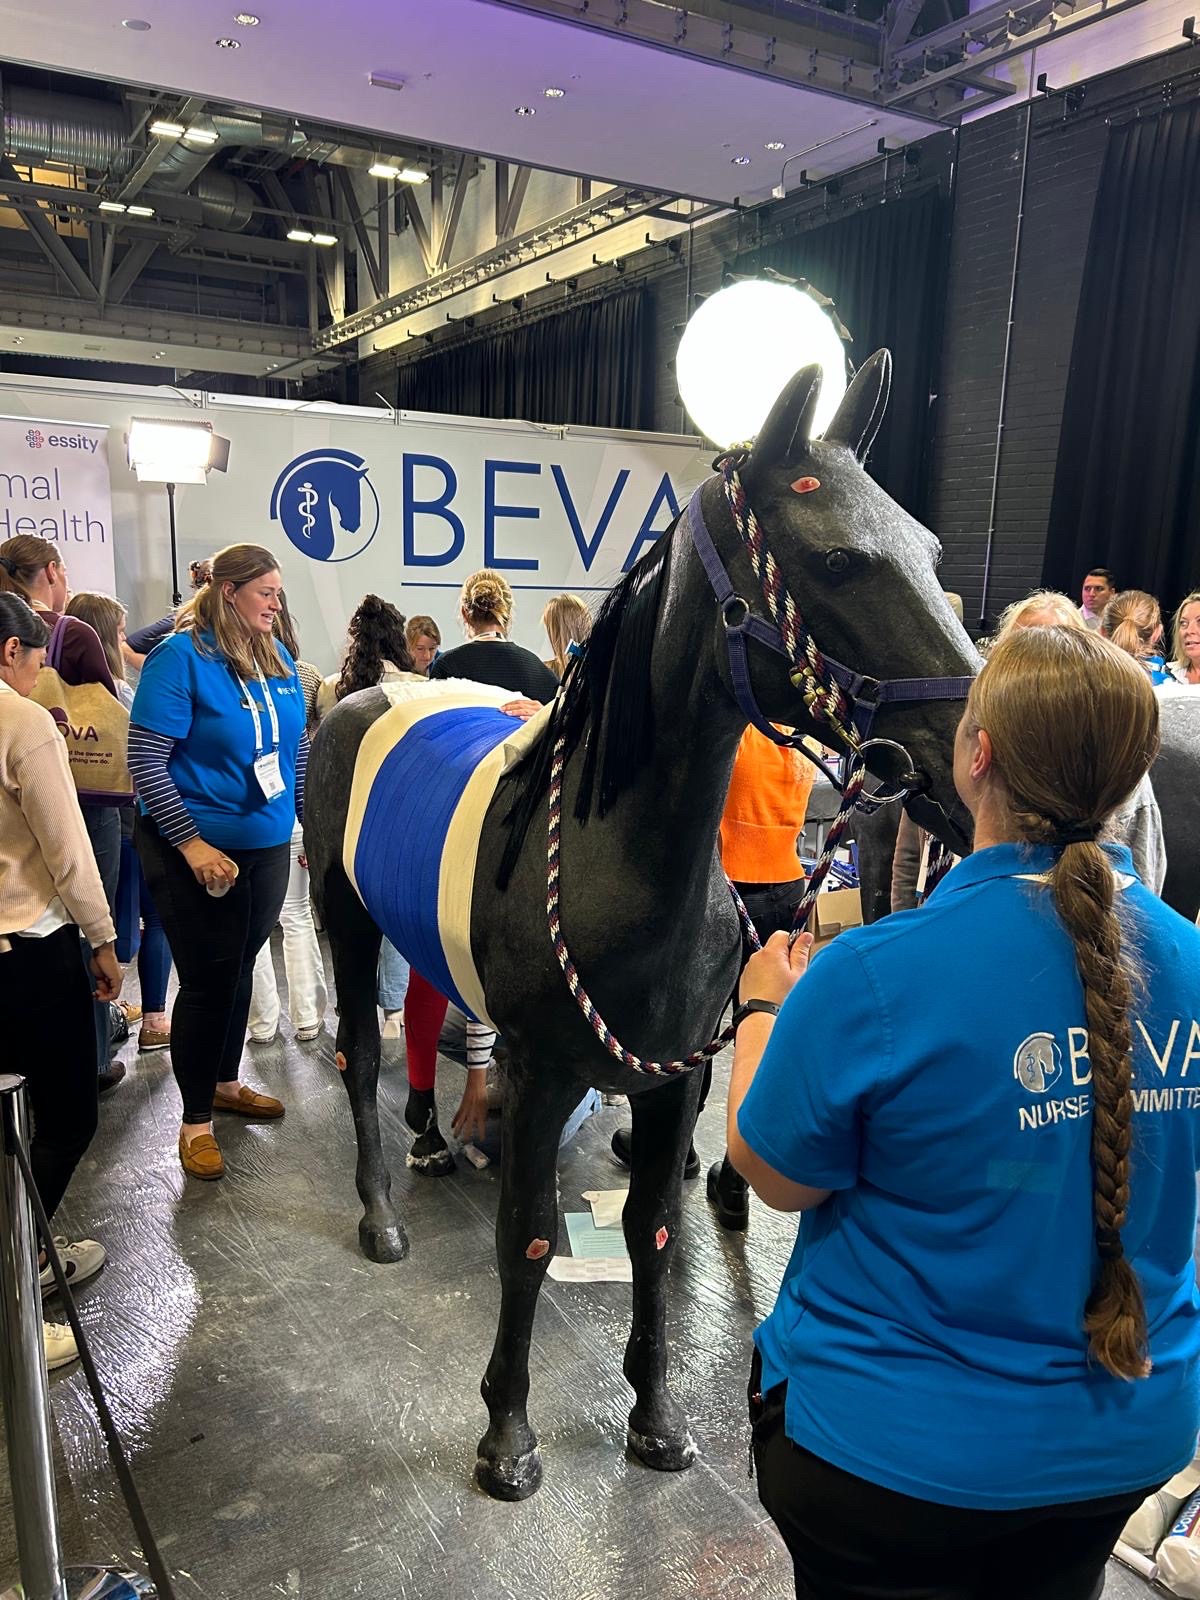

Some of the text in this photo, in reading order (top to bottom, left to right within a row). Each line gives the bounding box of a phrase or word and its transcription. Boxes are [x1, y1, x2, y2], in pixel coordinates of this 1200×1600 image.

[48, 434, 98, 454] essity
[402, 452, 684, 573] BEVA
[1068, 1020, 1200, 1086] BVA
[1018, 1094, 1090, 1131] NURSE
